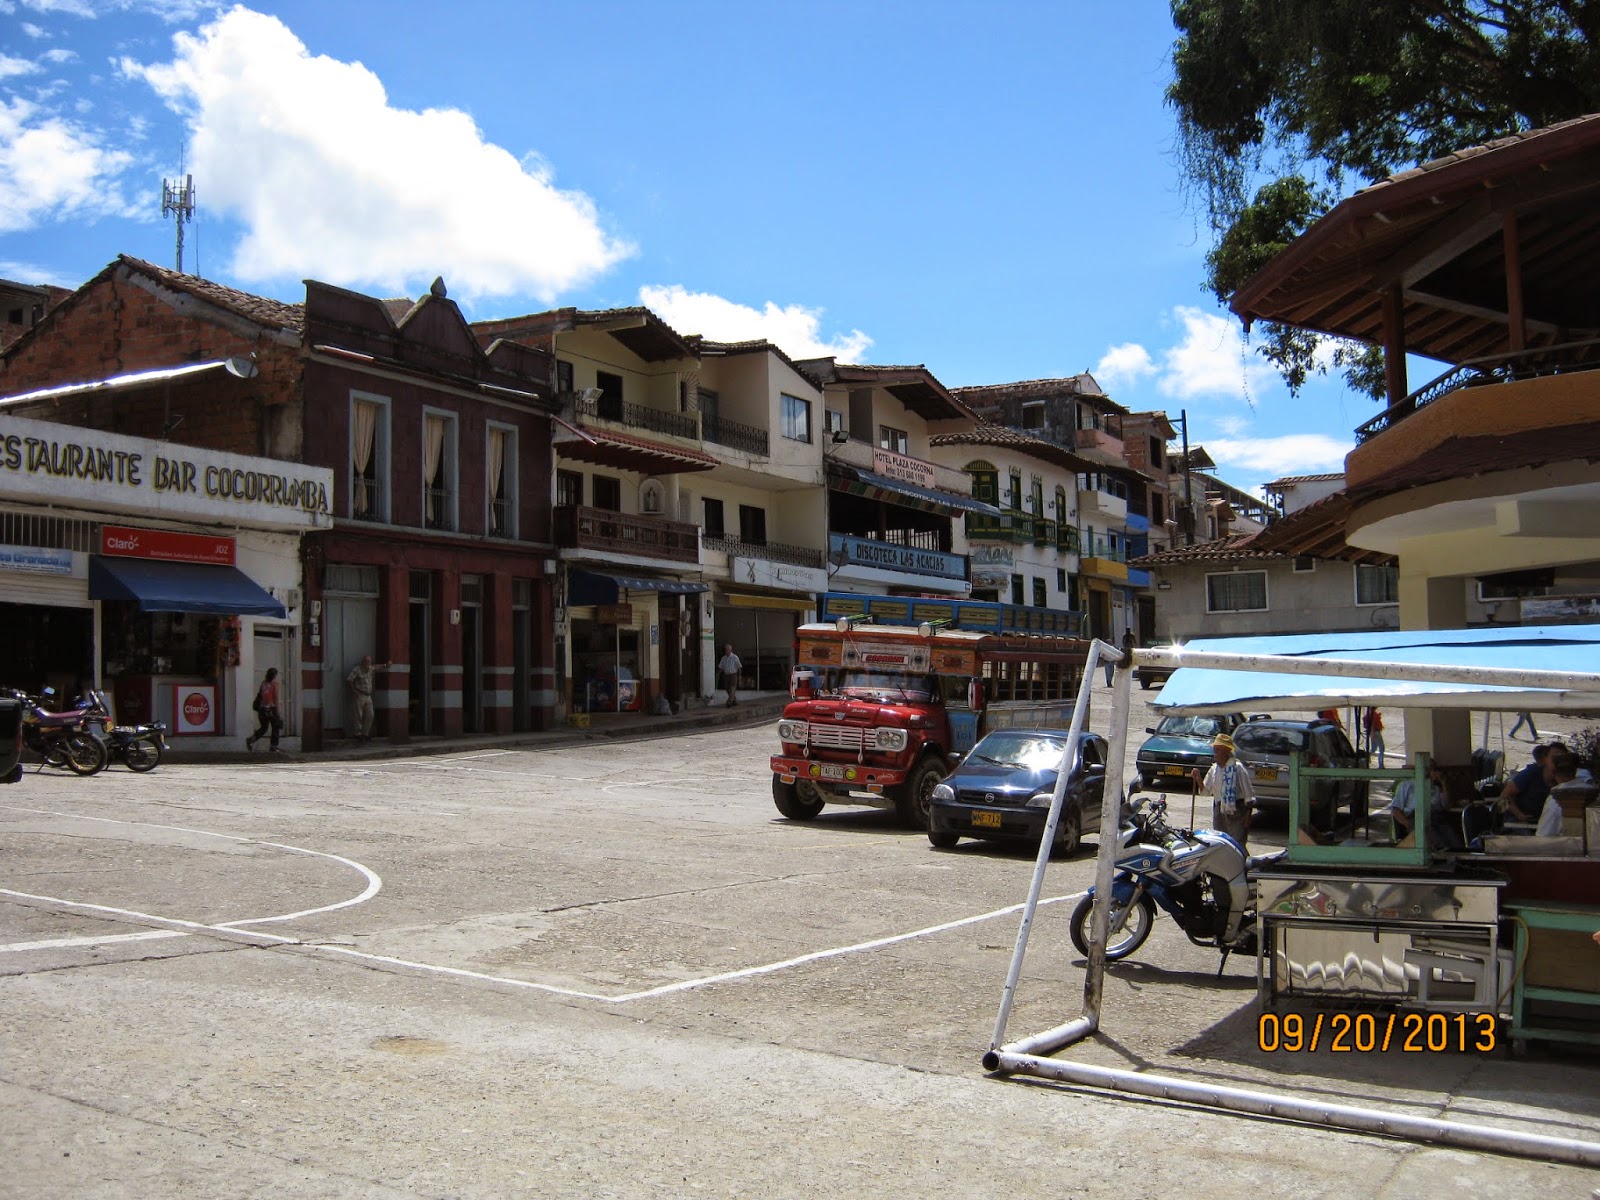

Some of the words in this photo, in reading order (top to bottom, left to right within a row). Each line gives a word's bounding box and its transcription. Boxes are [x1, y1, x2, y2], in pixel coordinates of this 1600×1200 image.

[874, 450, 892, 464] HOTEL
[892, 456, 910, 470] PLAZA
[154, 456, 196, 493] BAR
[205, 465, 328, 511] COCORRUMBA
[898, 488, 936, 503] DISCOTECA
[107, 536, 137, 550] Claro
[856, 543, 898, 565] DISCOTECA
[900, 551, 914, 566] LAS
[916, 554, 945, 572] ACACIAS
[184, 704, 206, 714] Claro
